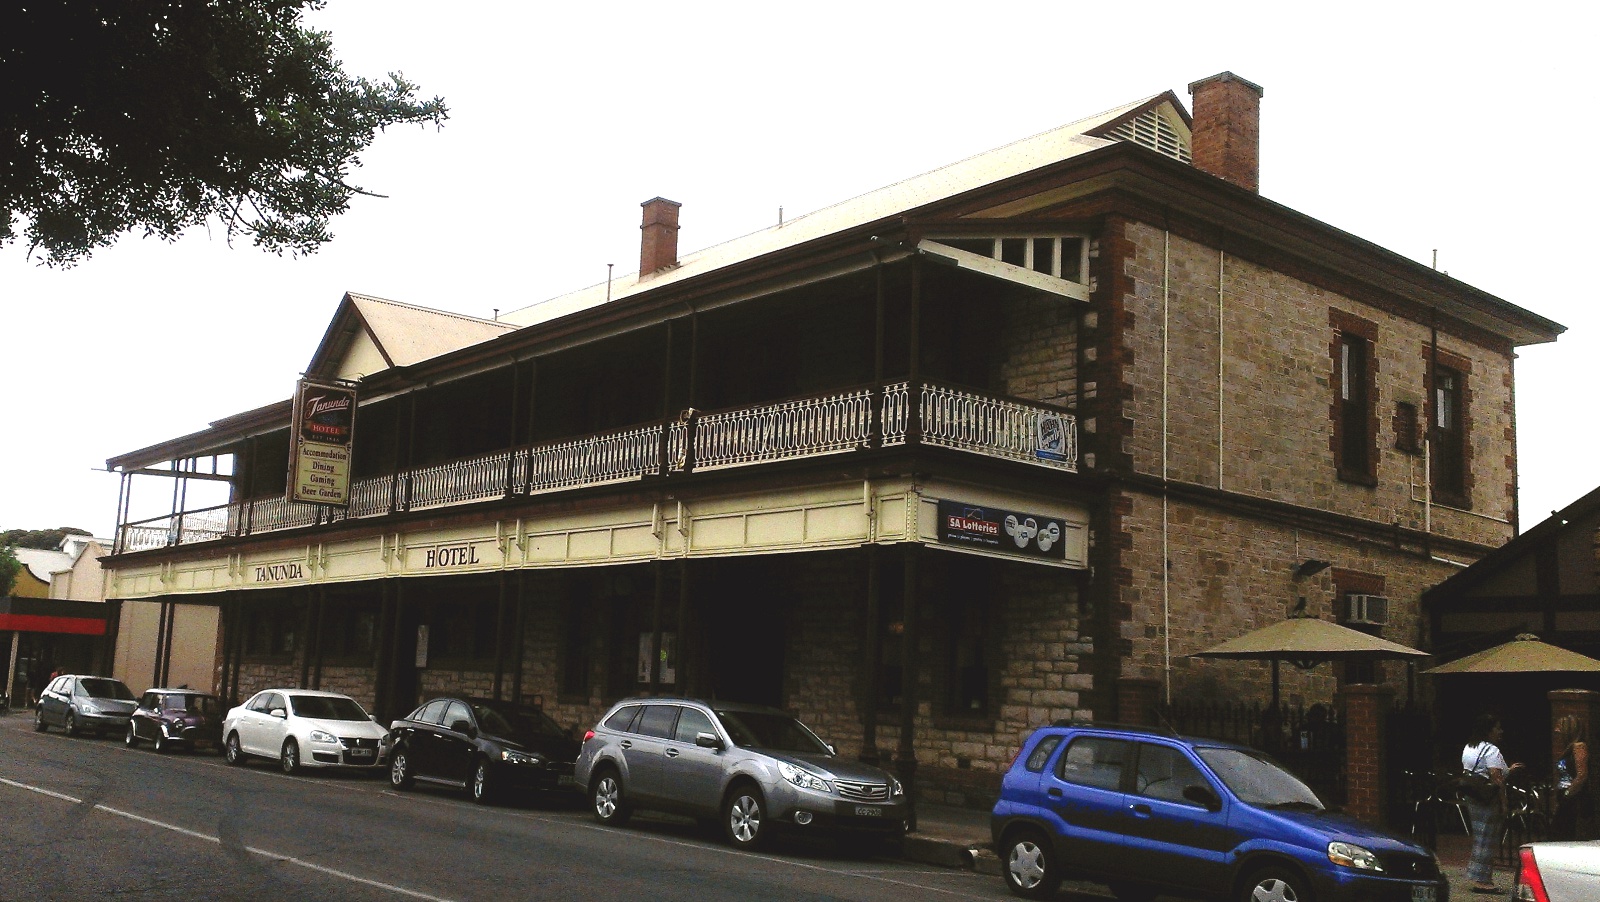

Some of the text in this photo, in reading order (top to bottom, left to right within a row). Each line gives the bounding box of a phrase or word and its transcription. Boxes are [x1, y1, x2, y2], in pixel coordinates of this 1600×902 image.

[305, 395, 350, 419] Tanunda
[313, 424, 339, 435] HOTEL
[302, 447, 347, 460] Accommodation
[312, 461, 335, 473] Dining
[310, 474, 335, 487] Gaming
[301, 485, 342, 499] Beer Garden
[949, 517, 961, 528] SA
[962, 519, 998, 534] Lotteries
[255, 546, 480, 582] TANUNDA HOTEL
